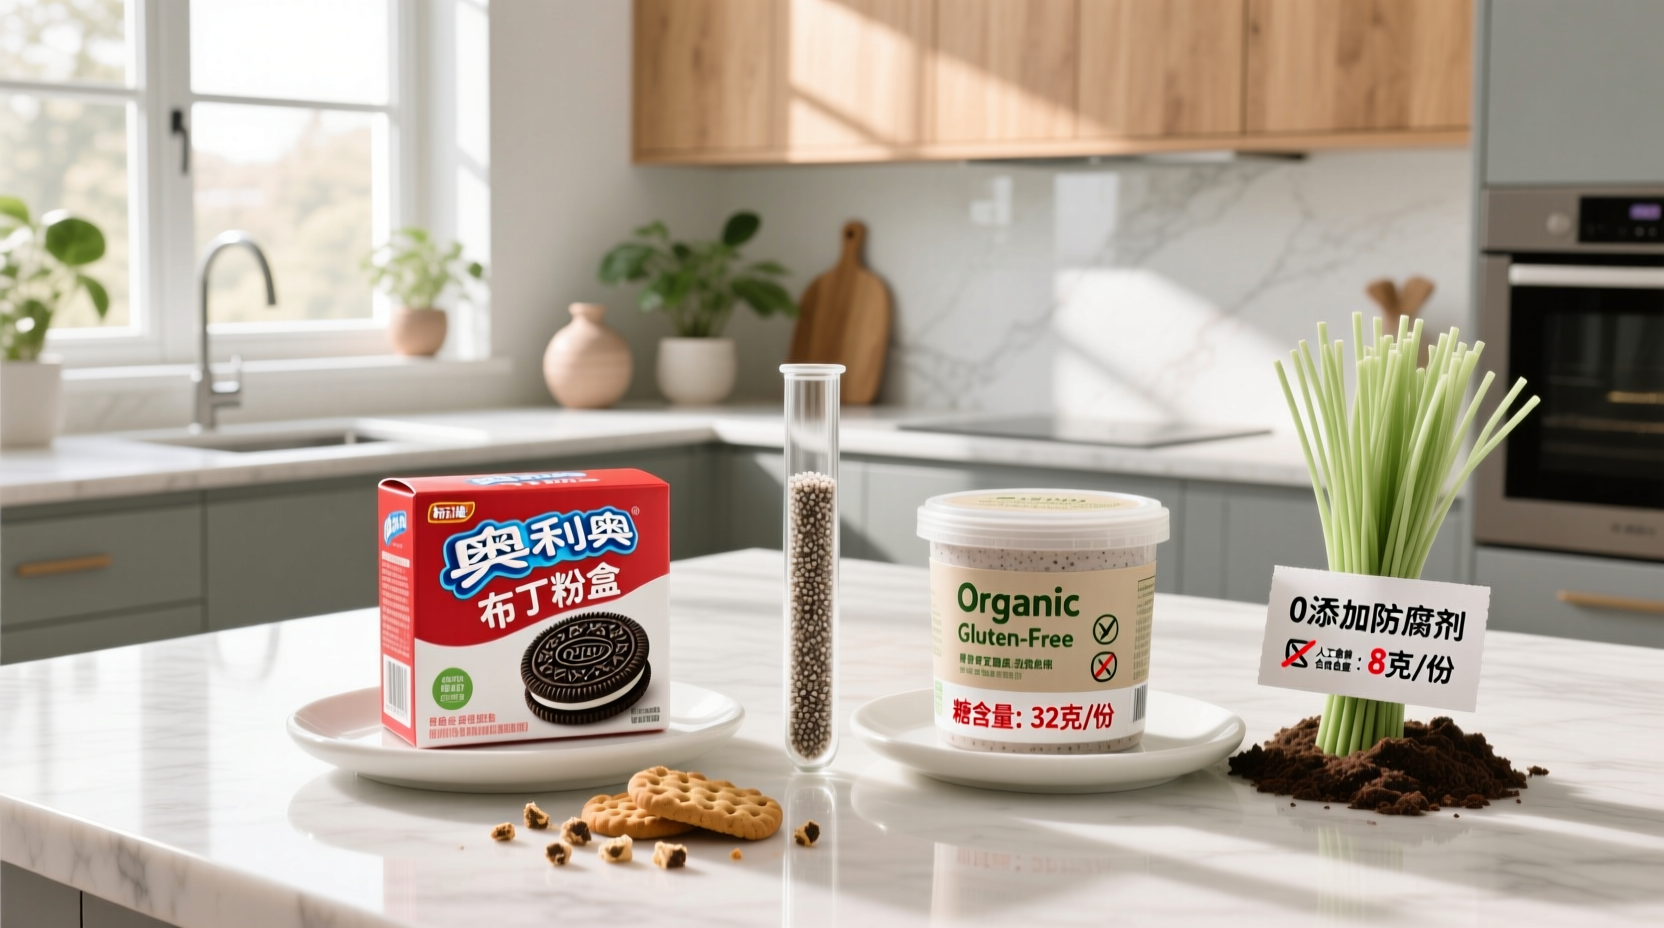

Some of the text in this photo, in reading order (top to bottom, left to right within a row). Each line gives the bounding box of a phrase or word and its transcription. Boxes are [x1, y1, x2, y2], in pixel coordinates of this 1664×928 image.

[450, 511, 634, 589] 奥利奥
[478, 562, 621, 629] 布丁粉盒
[957, 582, 1080, 625] Organic
[1289, 595, 1466, 642] 0添加防腐剂
[958, 622, 1074, 648] Gluten-Free
